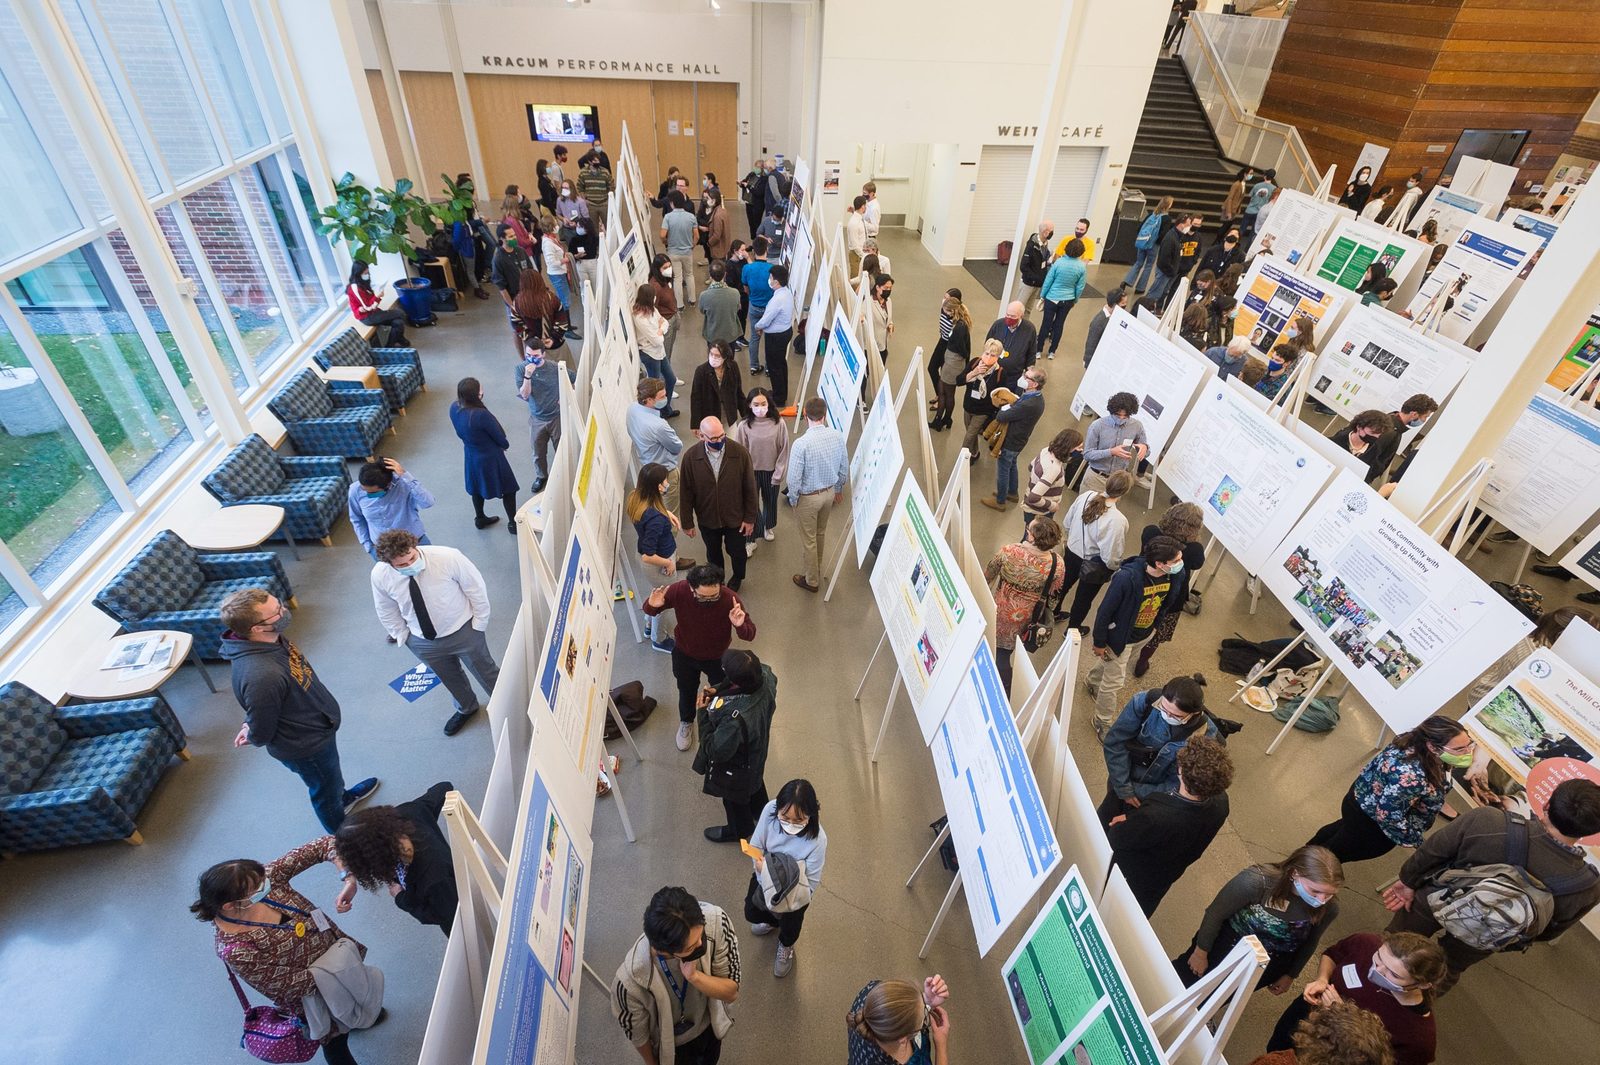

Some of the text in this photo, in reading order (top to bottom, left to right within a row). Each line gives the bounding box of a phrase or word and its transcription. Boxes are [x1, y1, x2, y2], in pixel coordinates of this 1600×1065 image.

[483, 56, 721, 75] KRACUM PERFORMANCE HALL
[998, 124, 1104, 138] WEIT CAFÉ
[1376, 527, 1430, 573] Growing Up Healthy
[1379, 517, 1441, 569] In the Community with
[1565, 678, 1578, 691] The
[1577, 688, 1593, 703] Mill
[1067, 922, 1091, 969] Background
[1038, 972, 1052, 1008] Methods
[1084, 922, 1119, 987] Characterization
[1115, 987, 1123, 996] of
[1120, 996, 1144, 1043] Secondary
[1102, 972, 1114, 993] Emily
